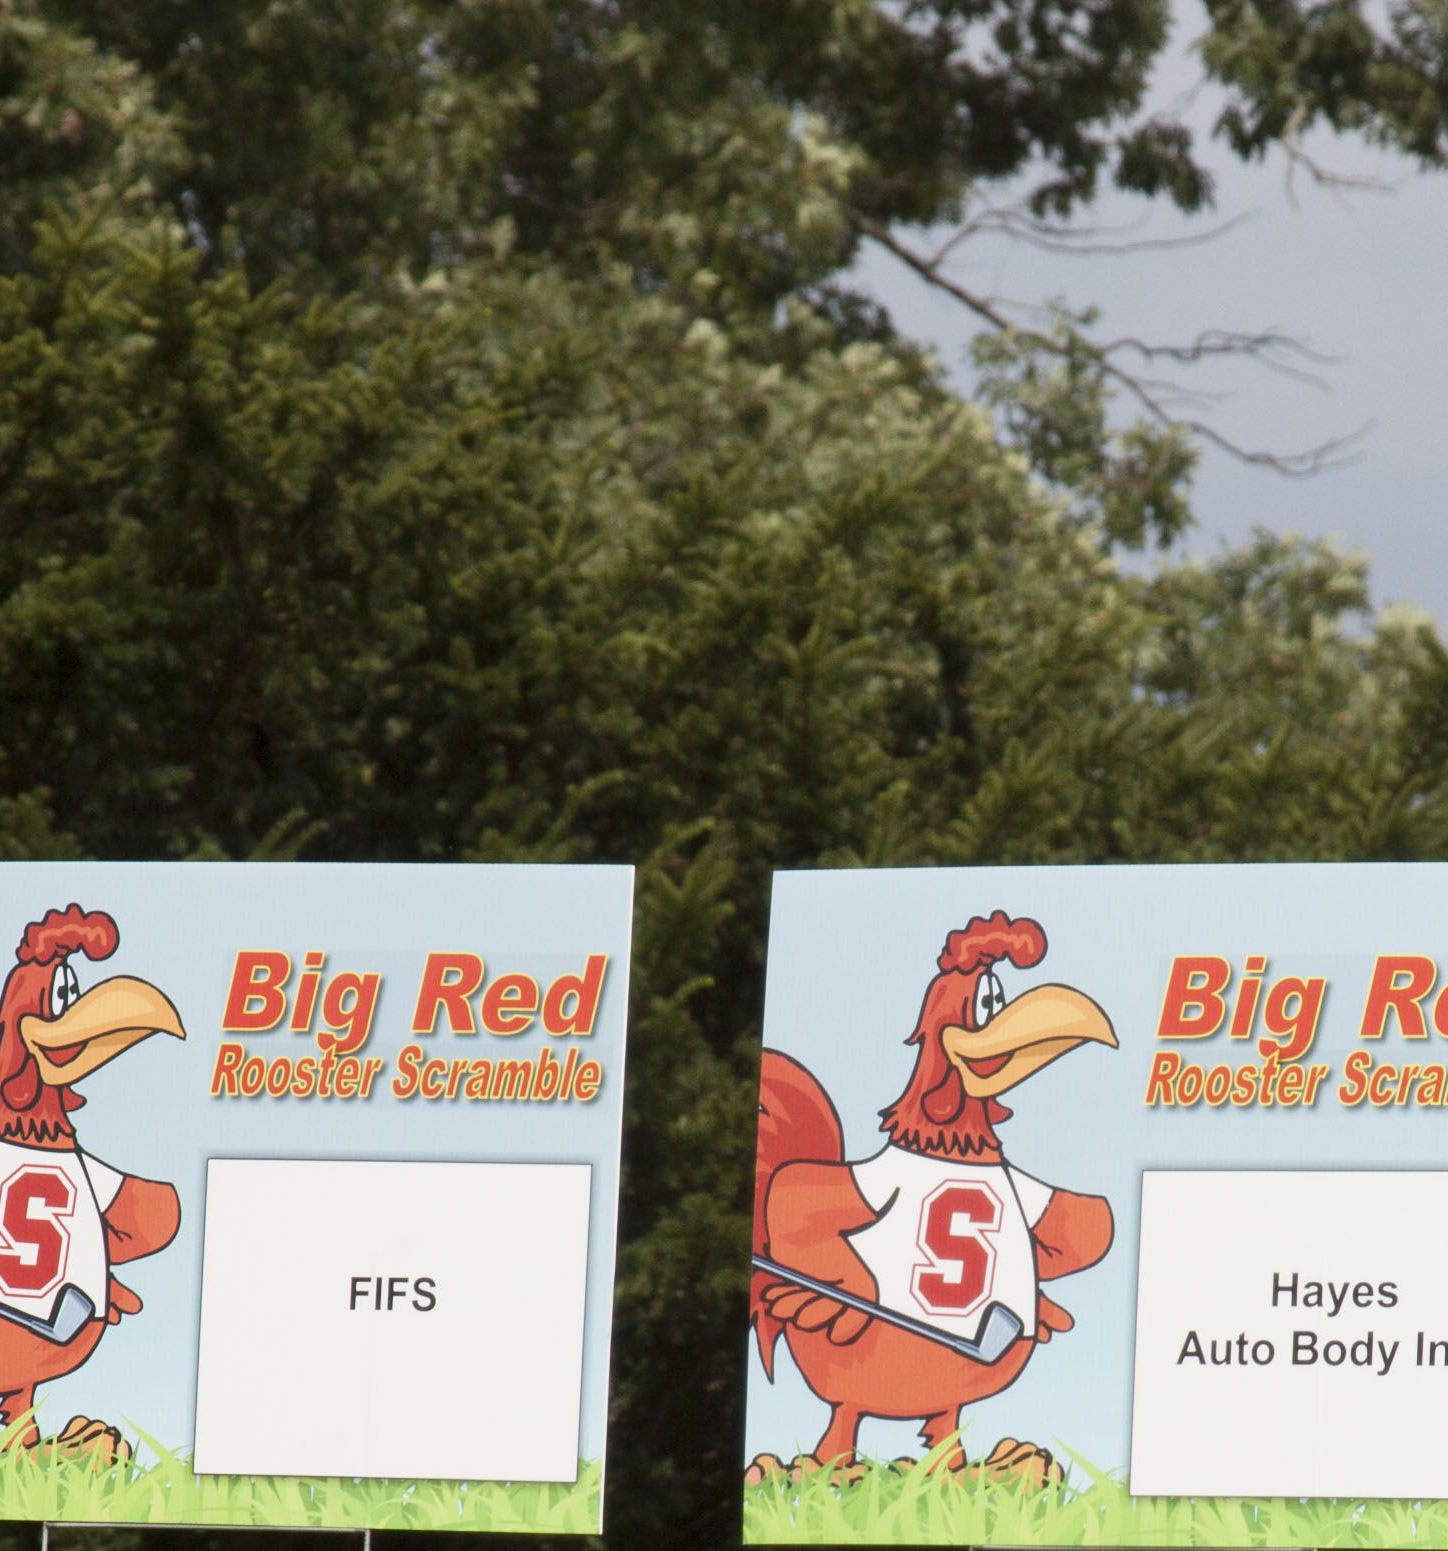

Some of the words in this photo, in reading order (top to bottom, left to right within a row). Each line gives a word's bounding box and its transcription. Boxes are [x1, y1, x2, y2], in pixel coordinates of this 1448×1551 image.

[219, 950, 380, 1051] Big
[412, 952, 607, 1036] Red
[1154, 956, 1325, 1059] Big
[211, 1041, 383, 1097] Rooster
[393, 1045, 601, 1100] Scramble
[1146, 1050, 1328, 1105] Rooster
[911, 1179, 1003, 1317] S
[351, 1277, 435, 1311] FIFS
[1273, 1273, 1397, 1316] Hayes
[1177, 1331, 1274, 1365] Auto
[1292, 1332, 1399, 1375] Body
